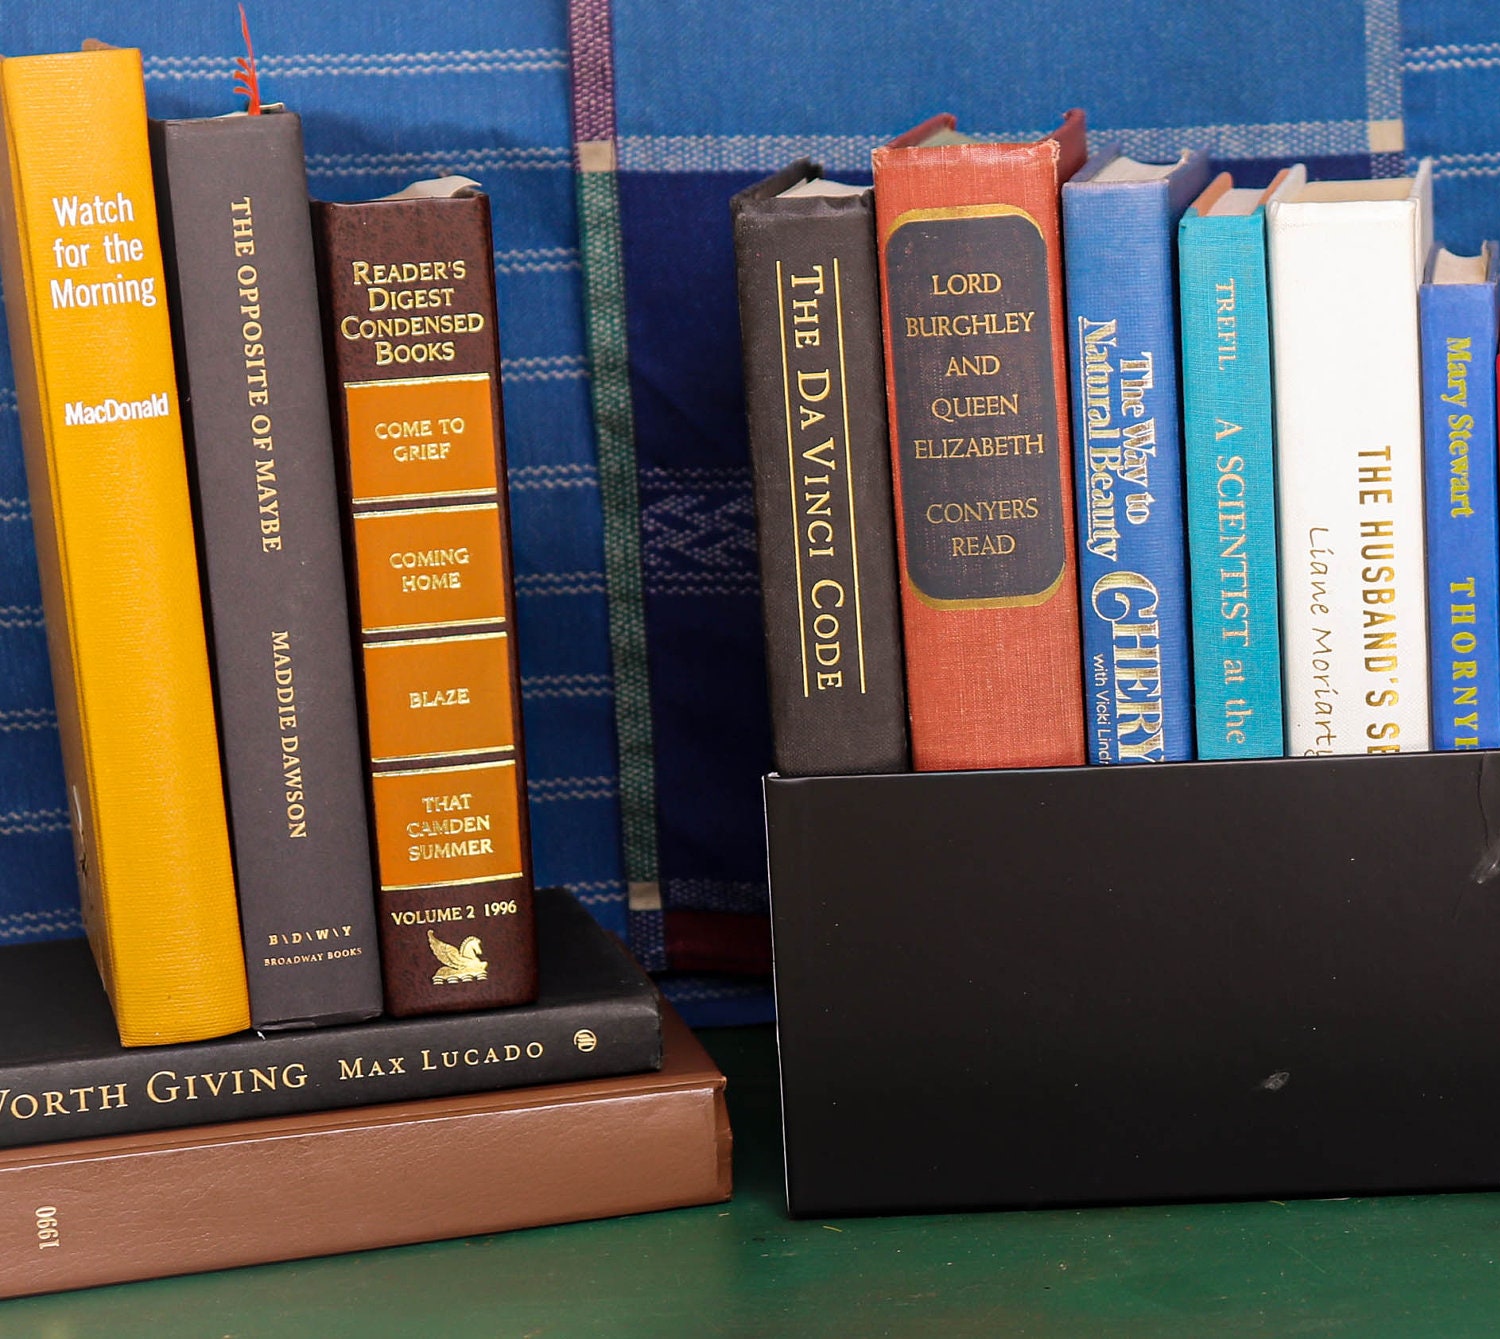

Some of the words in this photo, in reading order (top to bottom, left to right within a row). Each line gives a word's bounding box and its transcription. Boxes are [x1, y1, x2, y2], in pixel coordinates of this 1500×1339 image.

[53, 192, 134, 227] Watch
[231, 197, 255, 257] THE
[53, 238, 90, 268] for
[104, 233, 143, 264] the
[352, 260, 466, 286] READER'S
[932, 273, 1002, 296] LORD
[50, 274, 156, 309] Morning
[368, 287, 454, 311] DIGEST
[237, 265, 268, 406] OPPOSITE
[341, 313, 485, 340] CONDENSED
[906, 311, 1035, 337] BURGHLEY
[1215, 278, 1235, 371] TREFIL
[375, 341, 455, 366] BOOKS
[946, 354, 1001, 377] AND
[1084, 318, 1121, 440] Natural
[1119, 351, 1154, 417] The
[1440, 337, 1472, 408] Mary
[65, 393, 168, 426] MacDonald
[931, 393, 1019, 423] QUEEN
[252, 414, 273, 451] OF
[375, 420, 432, 440] COME
[439, 417, 464, 435] TO
[1214, 416, 1244, 441] A
[393, 442, 451, 462] GRIEF
[914, 433, 1044, 460] ELIZABETH
[1116, 417, 1156, 488] Way
[791, 265, 824, 348] THE
[811, 579, 845, 691] CODE
[1357, 445, 1392, 505] THE
[1447, 414, 1475, 518] Stewart
[256, 459, 283, 553] MAYBE
[926, 497, 1039, 524] CONYERS
[1087, 446, 1124, 562] Beauty
[1125, 491, 1156, 525] to
[389, 548, 470, 569] COMING
[952, 534, 1016, 558] READ
[1215, 456, 1250, 648] SCIENTIST
[402, 572, 461, 592] HOME
[1309, 527, 1335, 615] Liane
[1359, 520, 1400, 707] HUSBAND'S
[271, 631, 297, 730] MADDIE
[1093, 653, 1109, 687] with
[1223, 659, 1245, 685] at
[409, 688, 470, 709] BLAZE
[1096, 690, 1110, 724] Vicki
[1225, 695, 1254, 745] the
[281, 737, 307, 838] DAWSON
[422, 793, 473, 813] THAT
[407, 814, 490, 838] CAMDEN
[408, 838, 494, 862] SUMMER
[391, 905, 463, 926] VOLUME
[466, 905, 475, 919] 2
[484, 900, 517, 918] 1996
[264, 953, 323, 966] BROADWAY
[328, 948, 362, 959] BOOKS
[146, 1062, 308, 1106] GIVING
[339, 1052, 407, 1082] MAX
[421, 1040, 545, 1072] LUCADO
[35, 1205, 60, 1250] 1990
